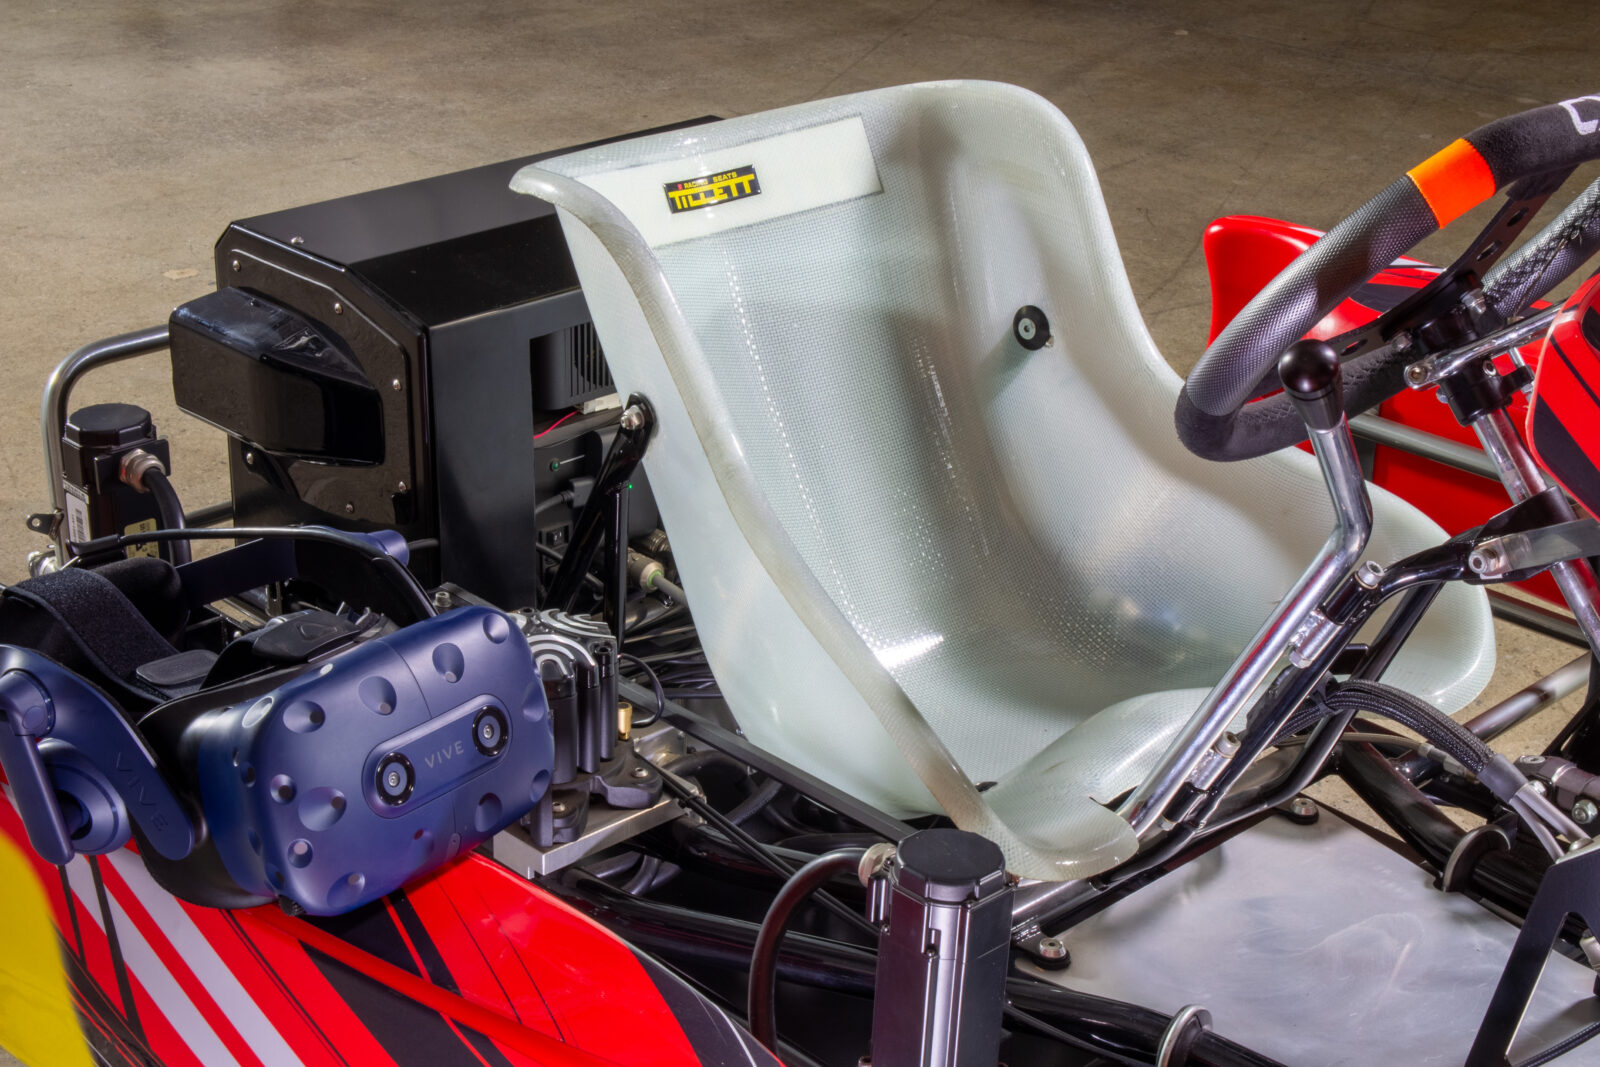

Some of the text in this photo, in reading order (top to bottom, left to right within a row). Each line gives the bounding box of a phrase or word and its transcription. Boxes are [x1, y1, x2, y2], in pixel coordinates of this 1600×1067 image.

[668, 173, 755, 210] TILLETT
[712, 171, 738, 183] SEATS
[424, 740, 465, 769] VIVE
[114, 751, 169, 832] VIVE
